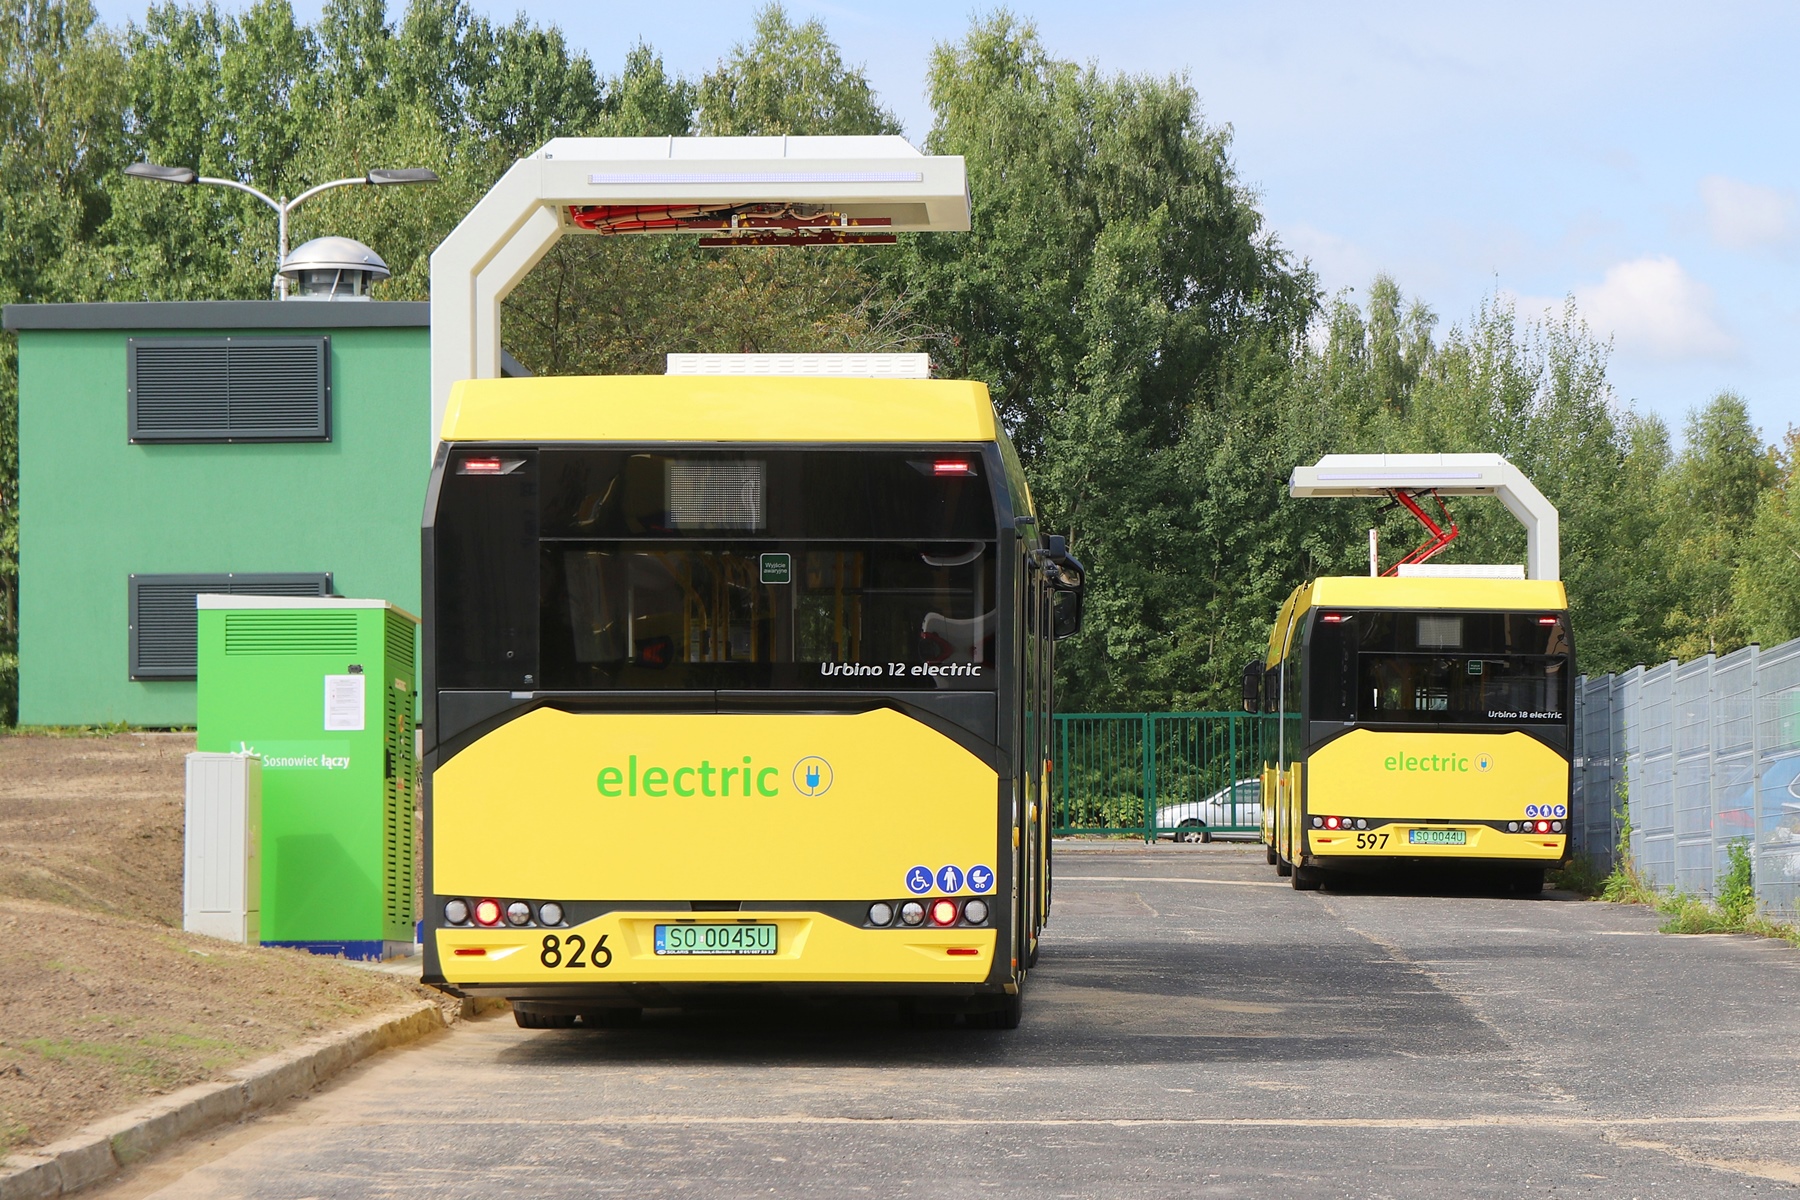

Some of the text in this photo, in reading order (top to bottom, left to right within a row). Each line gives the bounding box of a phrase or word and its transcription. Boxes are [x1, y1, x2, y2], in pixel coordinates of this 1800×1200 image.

[820, 662, 982, 676] Urbino 12 electric
[1488, 710, 1517, 718] Urbino
[1529, 711, 1563, 719] electric
[263, 754, 350, 770] Sosnowiec łączy
[1384, 752, 1469, 772] electric
[597, 755, 779, 797] electric
[1356, 833, 1390, 850] 597
[1416, 831, 1463, 842] SO 0044U
[670, 928, 770, 948] SO 0045U
[540, 934, 613, 968] 826
